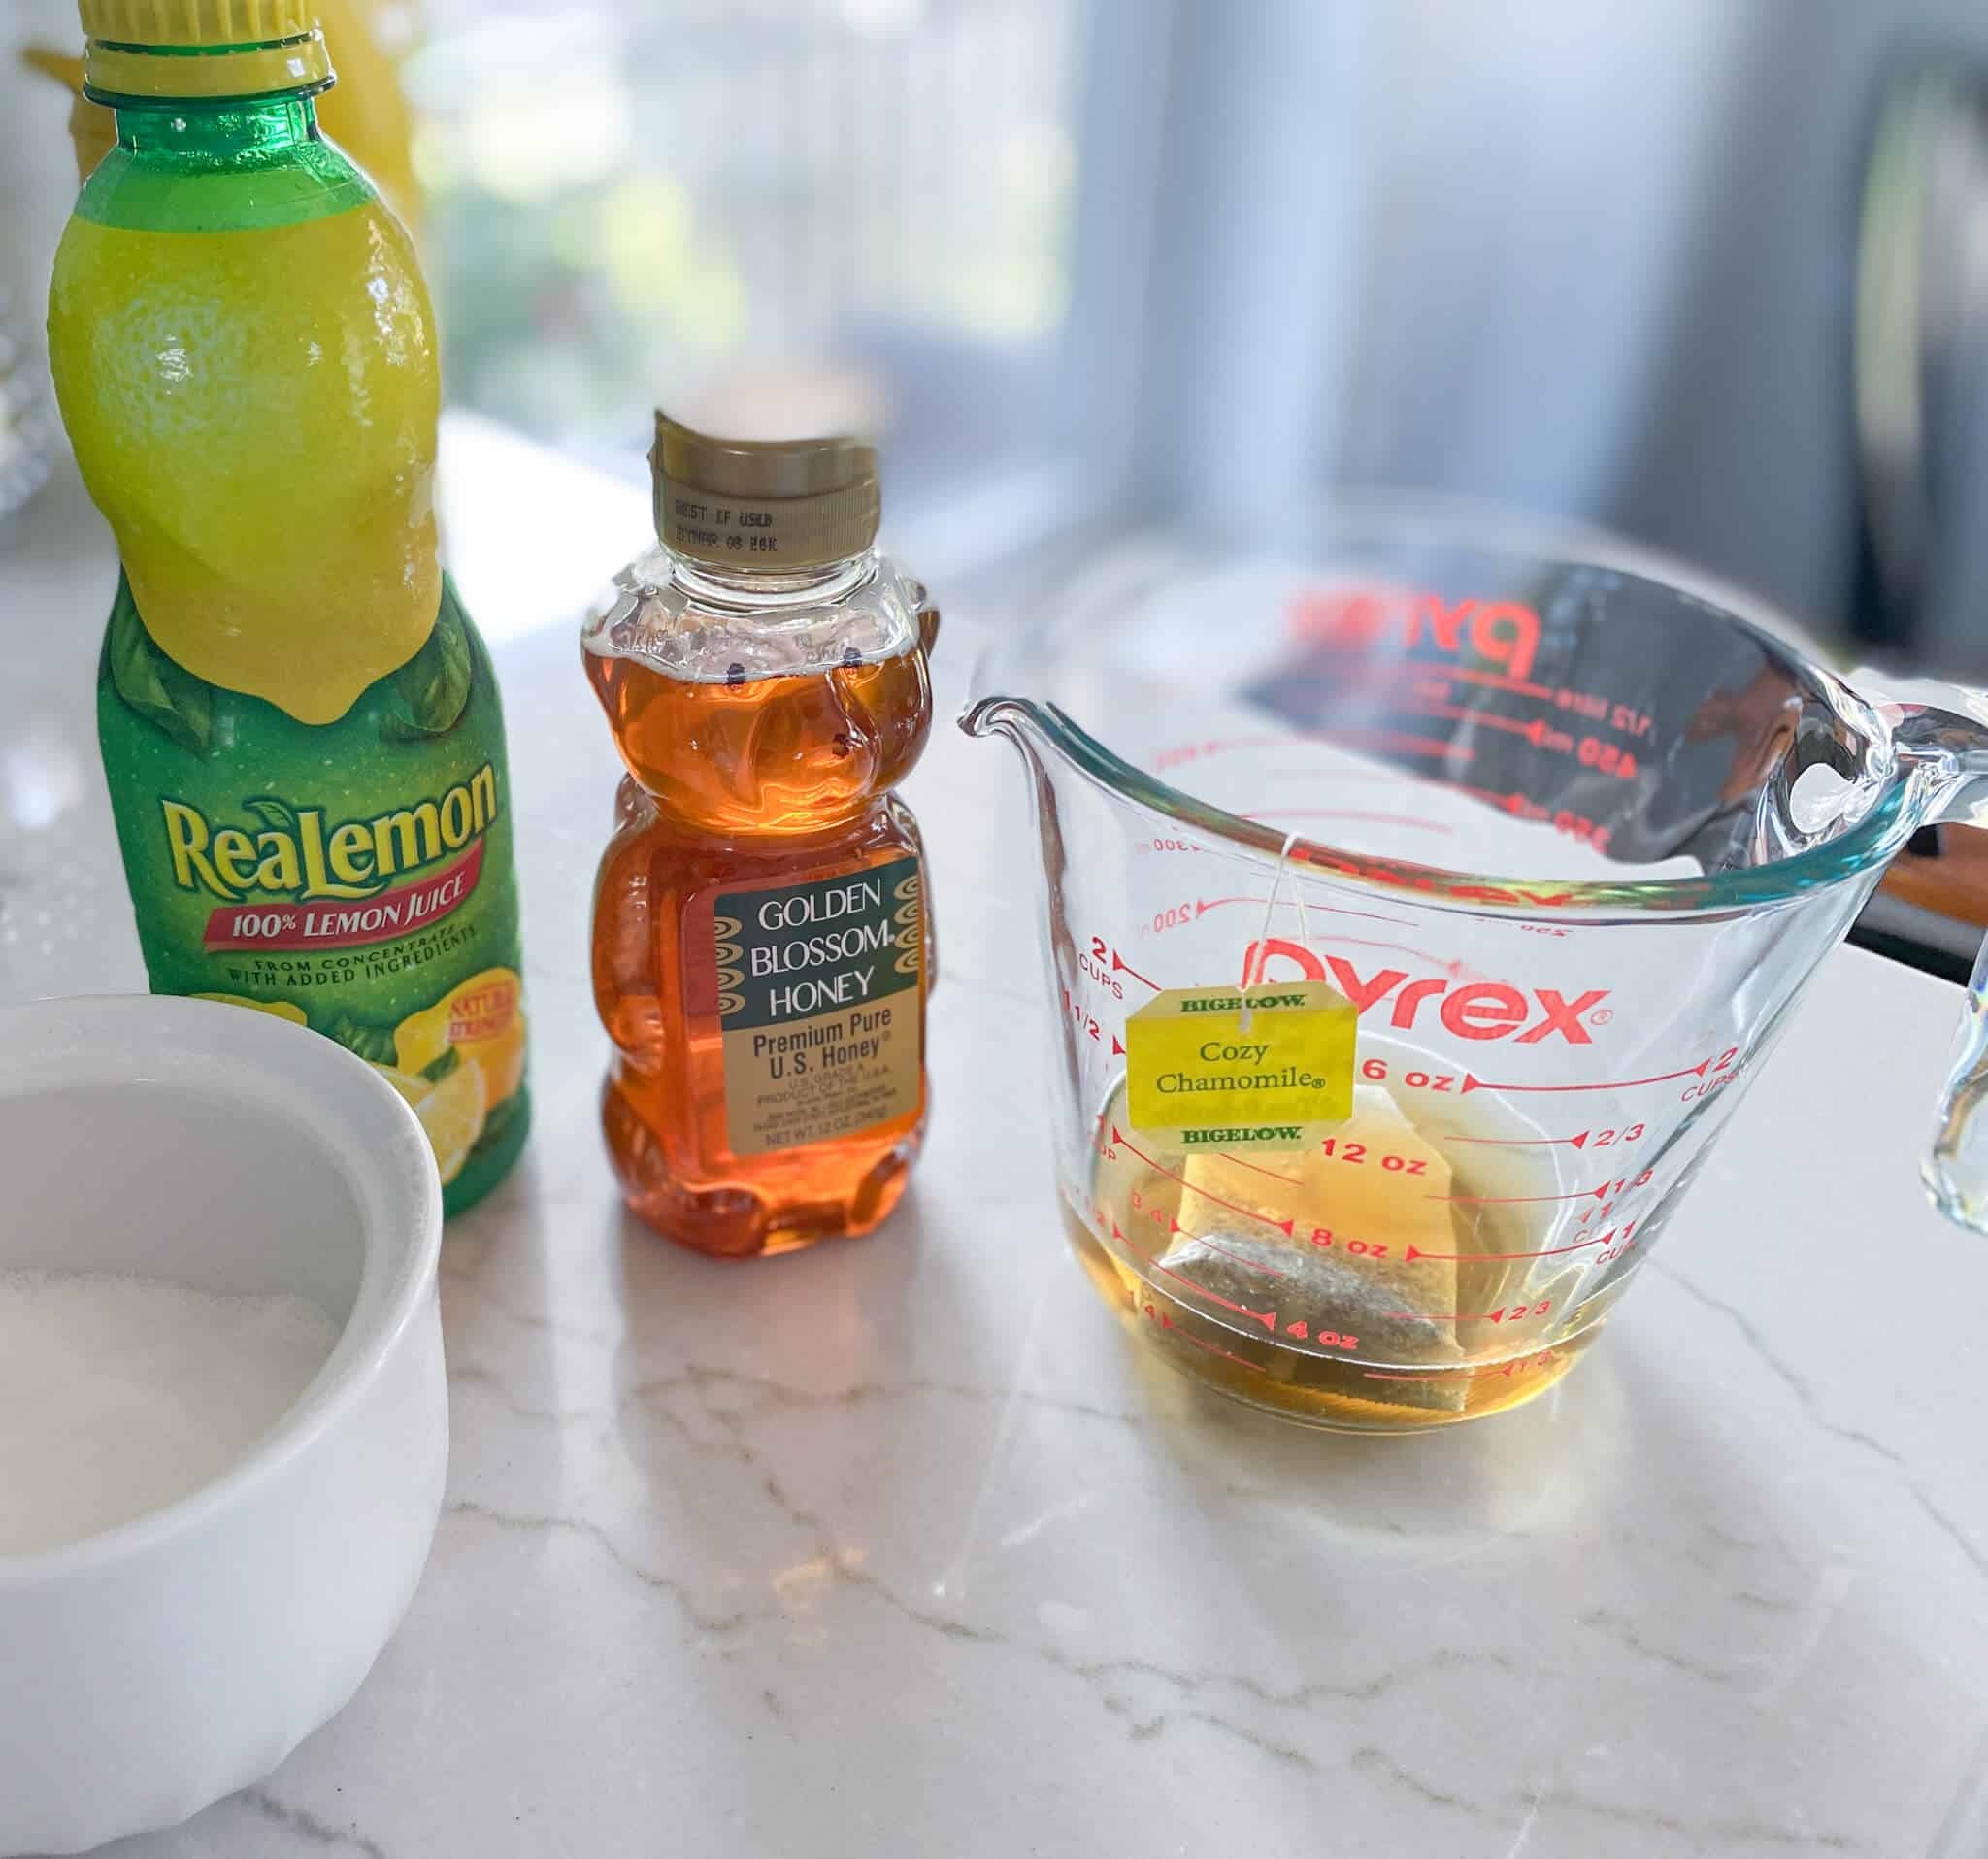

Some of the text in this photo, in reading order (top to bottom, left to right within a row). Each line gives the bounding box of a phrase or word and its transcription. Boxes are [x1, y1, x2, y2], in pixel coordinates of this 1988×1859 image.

[161, 762, 497, 901] ReaLemon
[232, 871, 466, 938] 100% LEMON JUICE
[758, 878, 881, 930] GOLDEN
[227, 926, 477, 987] WITH ADDED INGREDIENTS
[255, 924, 455, 972] FROM CONCENTRATE
[1092, 937, 1107, 964] 2
[770, 965, 875, 1016] HONEY
[1079, 953, 1123, 1000] CUPS
[753, 1009, 892, 1056] Premium Pure
[769, 1052, 813, 1079] U.S.
[1200, 1042, 1270, 1065] Cozy
[1712, 1047, 1739, 1072] 2
[1405, 1071, 1455, 1092] oz
[1592, 1123, 1645, 1147] 2/3
[1321, 1138, 1429, 1176] 12 oz
[1311, 1228, 1388, 1259] 8 oz
[1287, 1320, 1360, 1350] 4 oz
